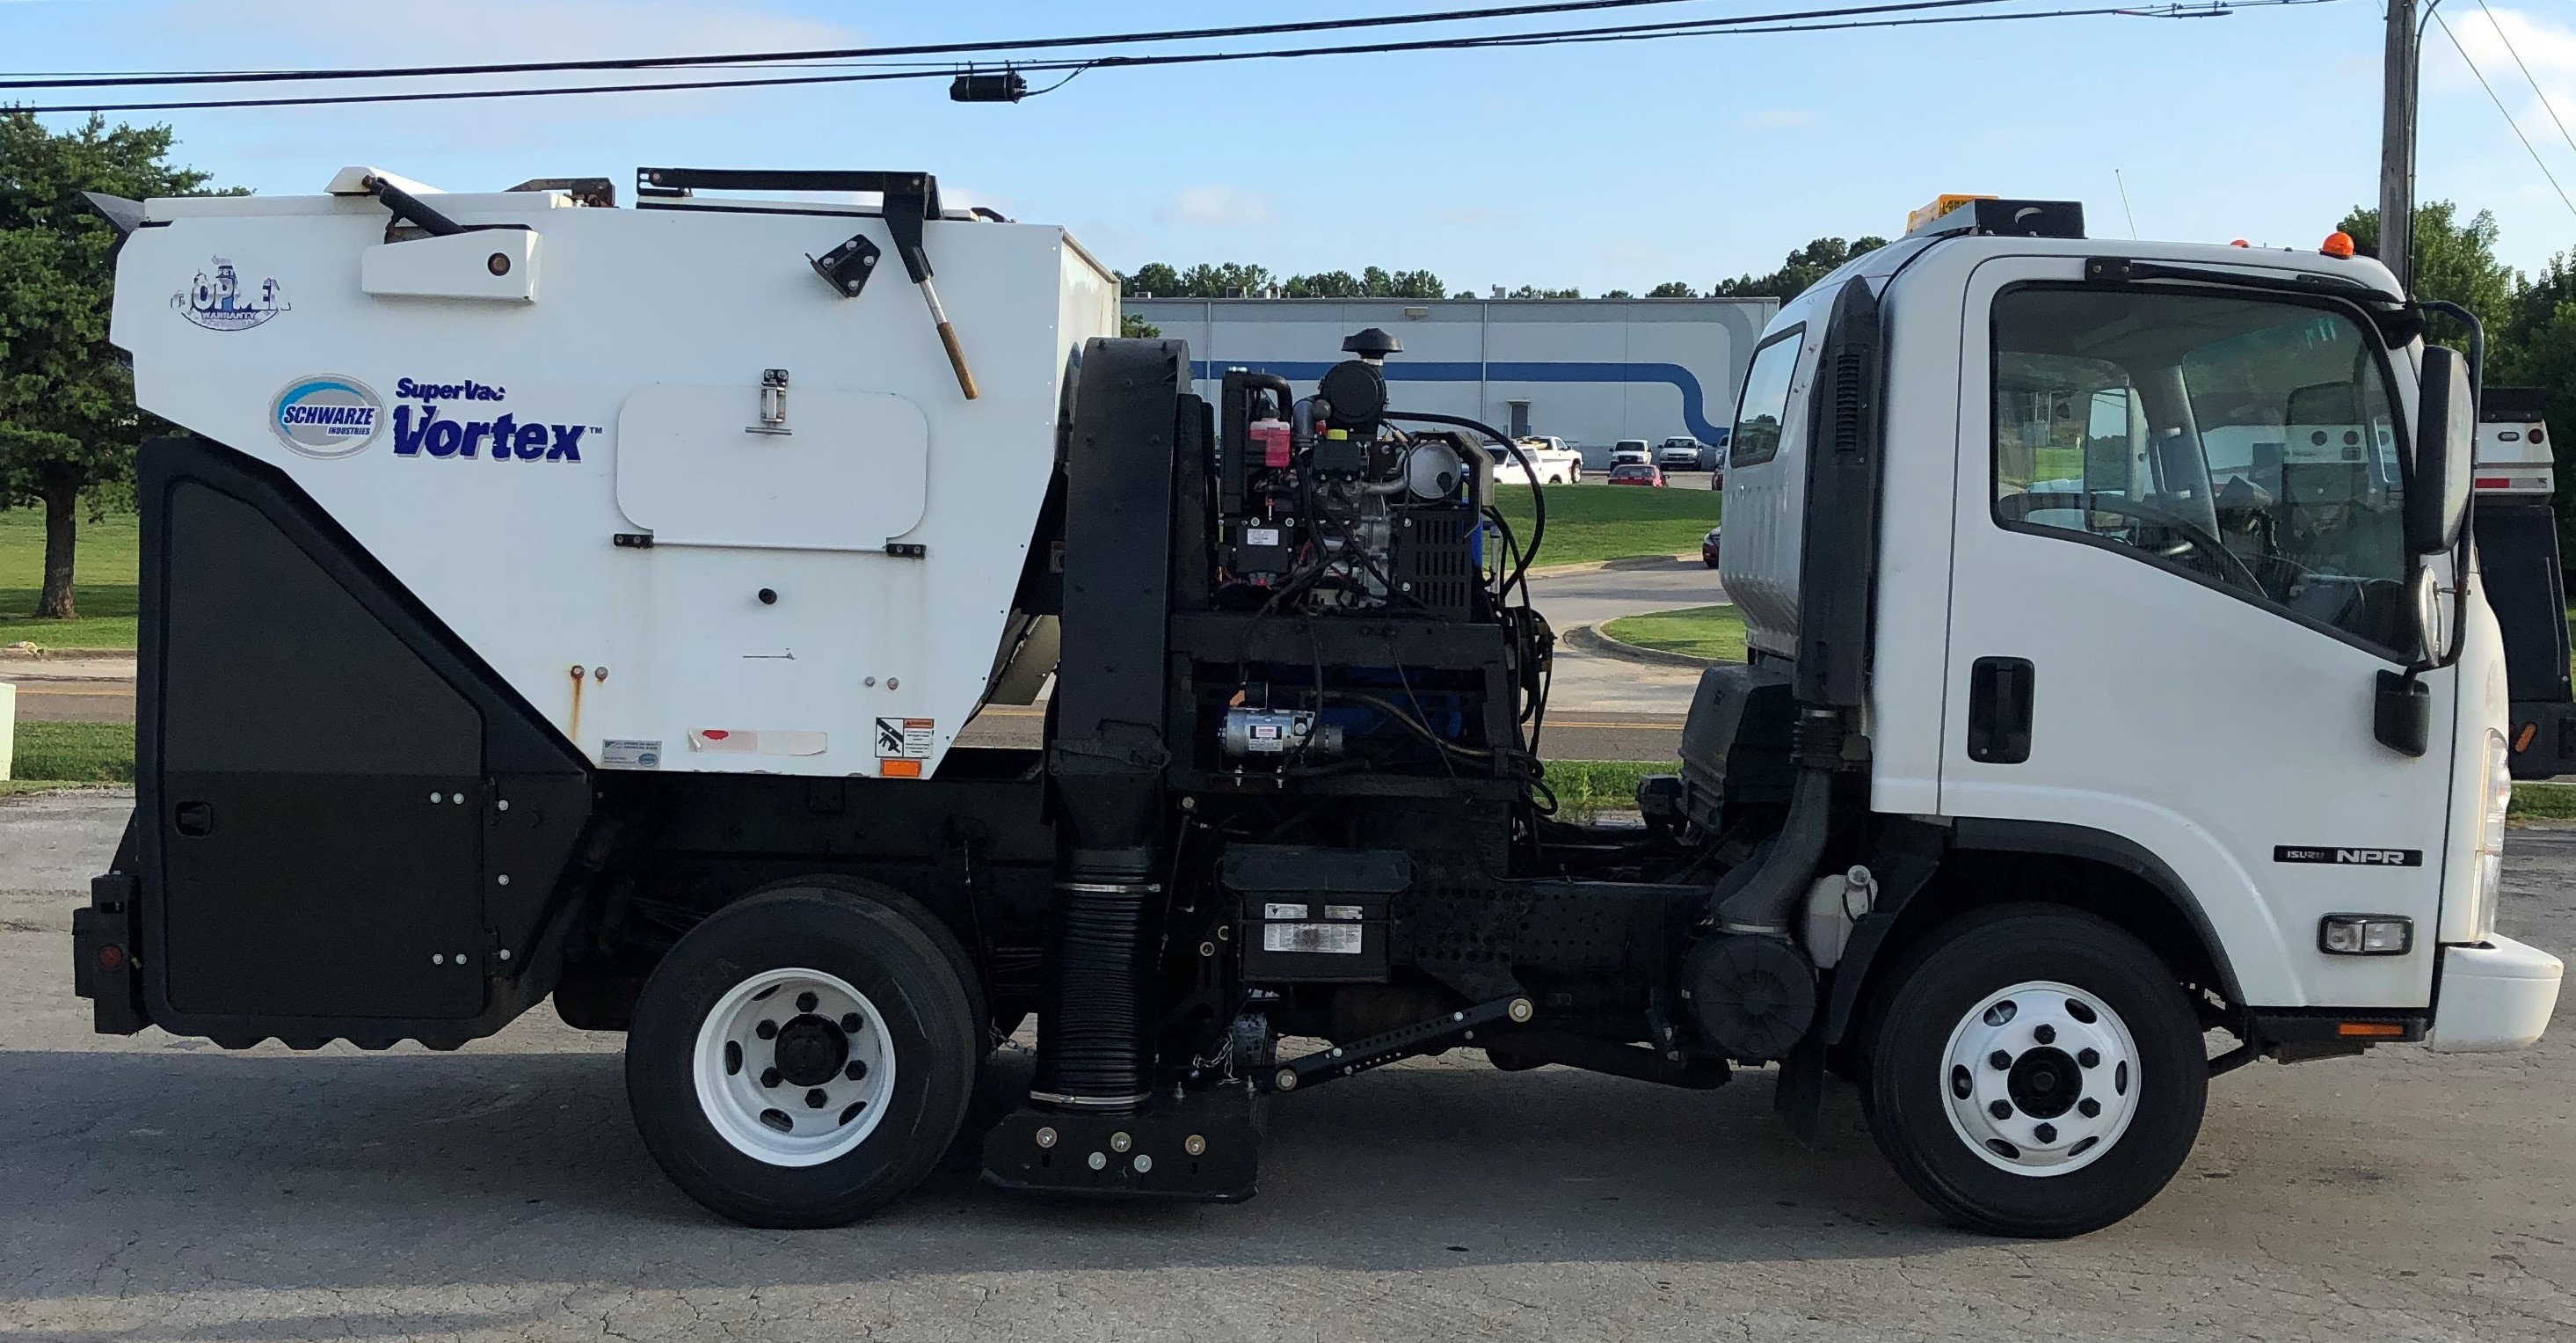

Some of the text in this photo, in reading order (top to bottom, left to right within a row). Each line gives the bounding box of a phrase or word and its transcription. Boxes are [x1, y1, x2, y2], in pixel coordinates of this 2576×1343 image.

[396, 377, 506, 404] SuperVac
[284, 405, 375, 426] SCHWARZE
[328, 427, 371, 435] INDUSTRIES
[393, 405, 586, 464] Vortex
[2336, 850, 2405, 865] NPR
